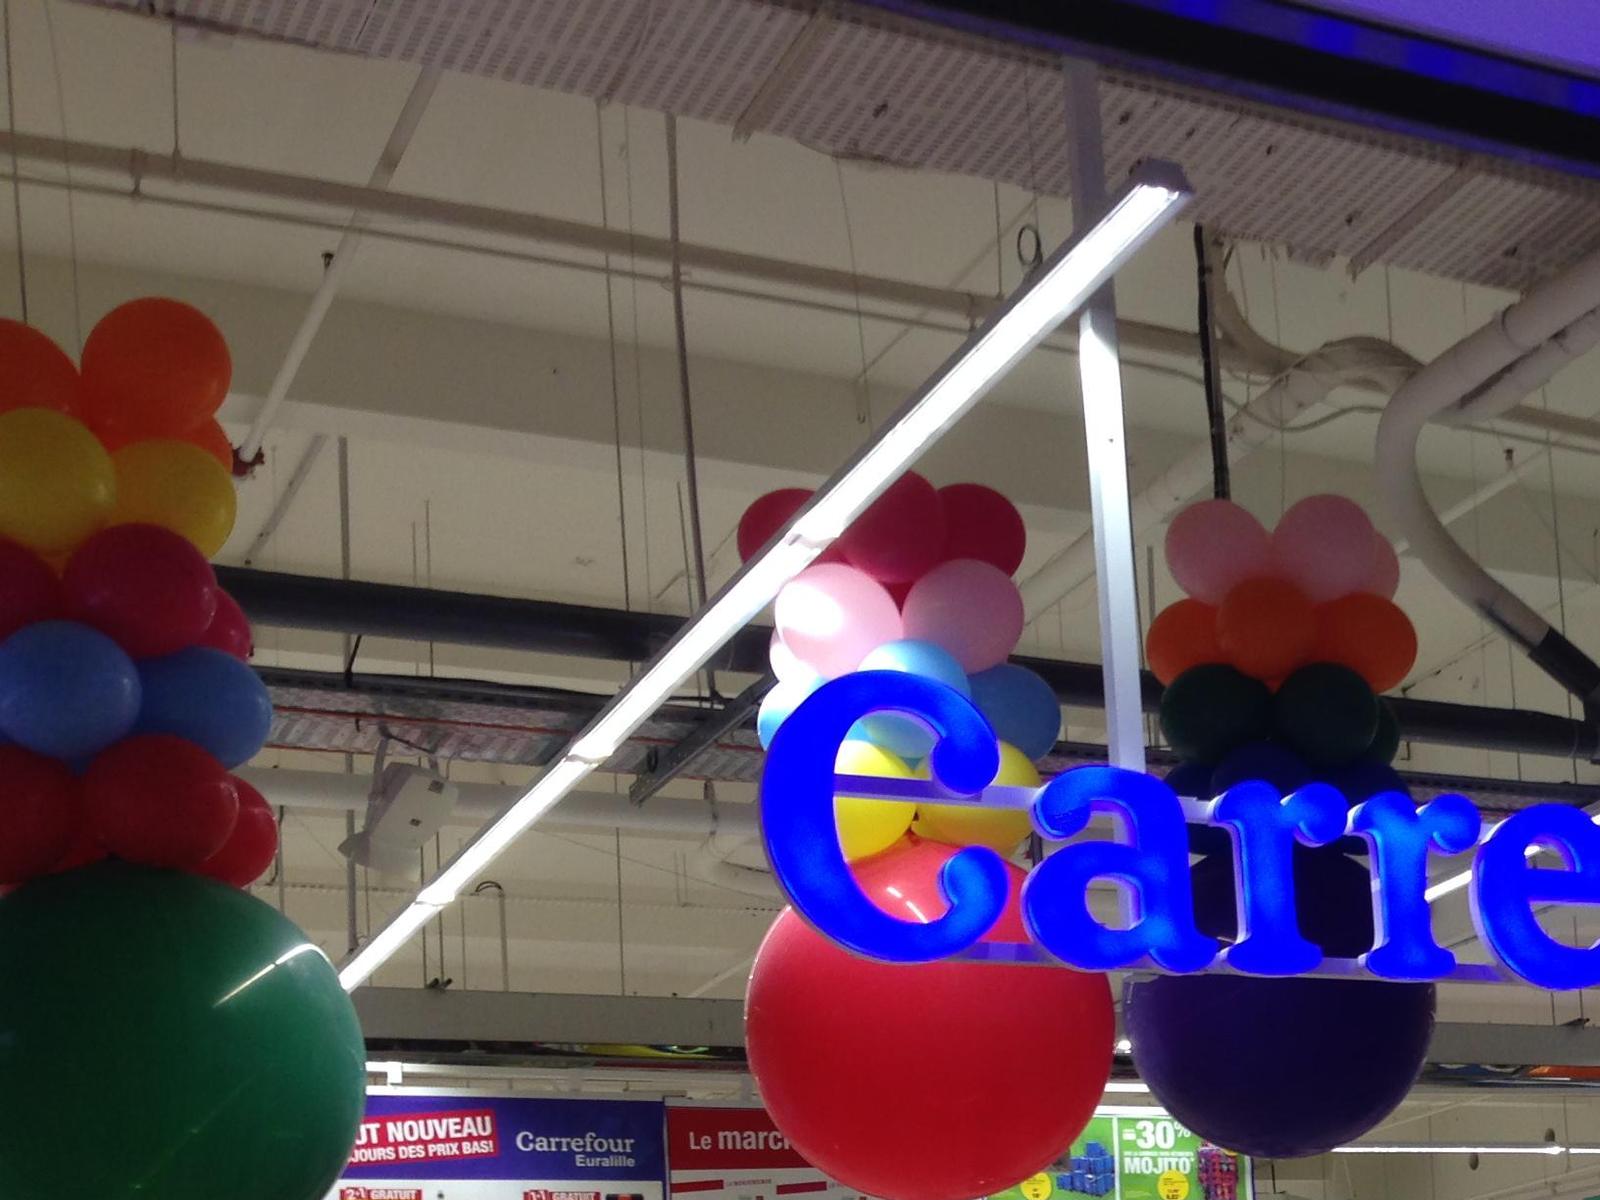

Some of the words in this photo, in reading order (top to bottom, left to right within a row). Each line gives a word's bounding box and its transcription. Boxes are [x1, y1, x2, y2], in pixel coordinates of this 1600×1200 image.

[387, 1116, 492, 1143] NOUVEAU
[515, 1131, 635, 1152] Carrefour
[689, 1131, 712, 1150] Le
[718, 1130, 793, 1150] marc
[351, 1147, 396, 1162] JOURS
[400, 1146, 425, 1160] DES
[429, 1143, 459, 1157] PRIX
[462, 1141, 494, 1155] BAS!
[575, 1154, 635, 1167] Euralille
[370, 1190, 417, 1200] GRATUIT
